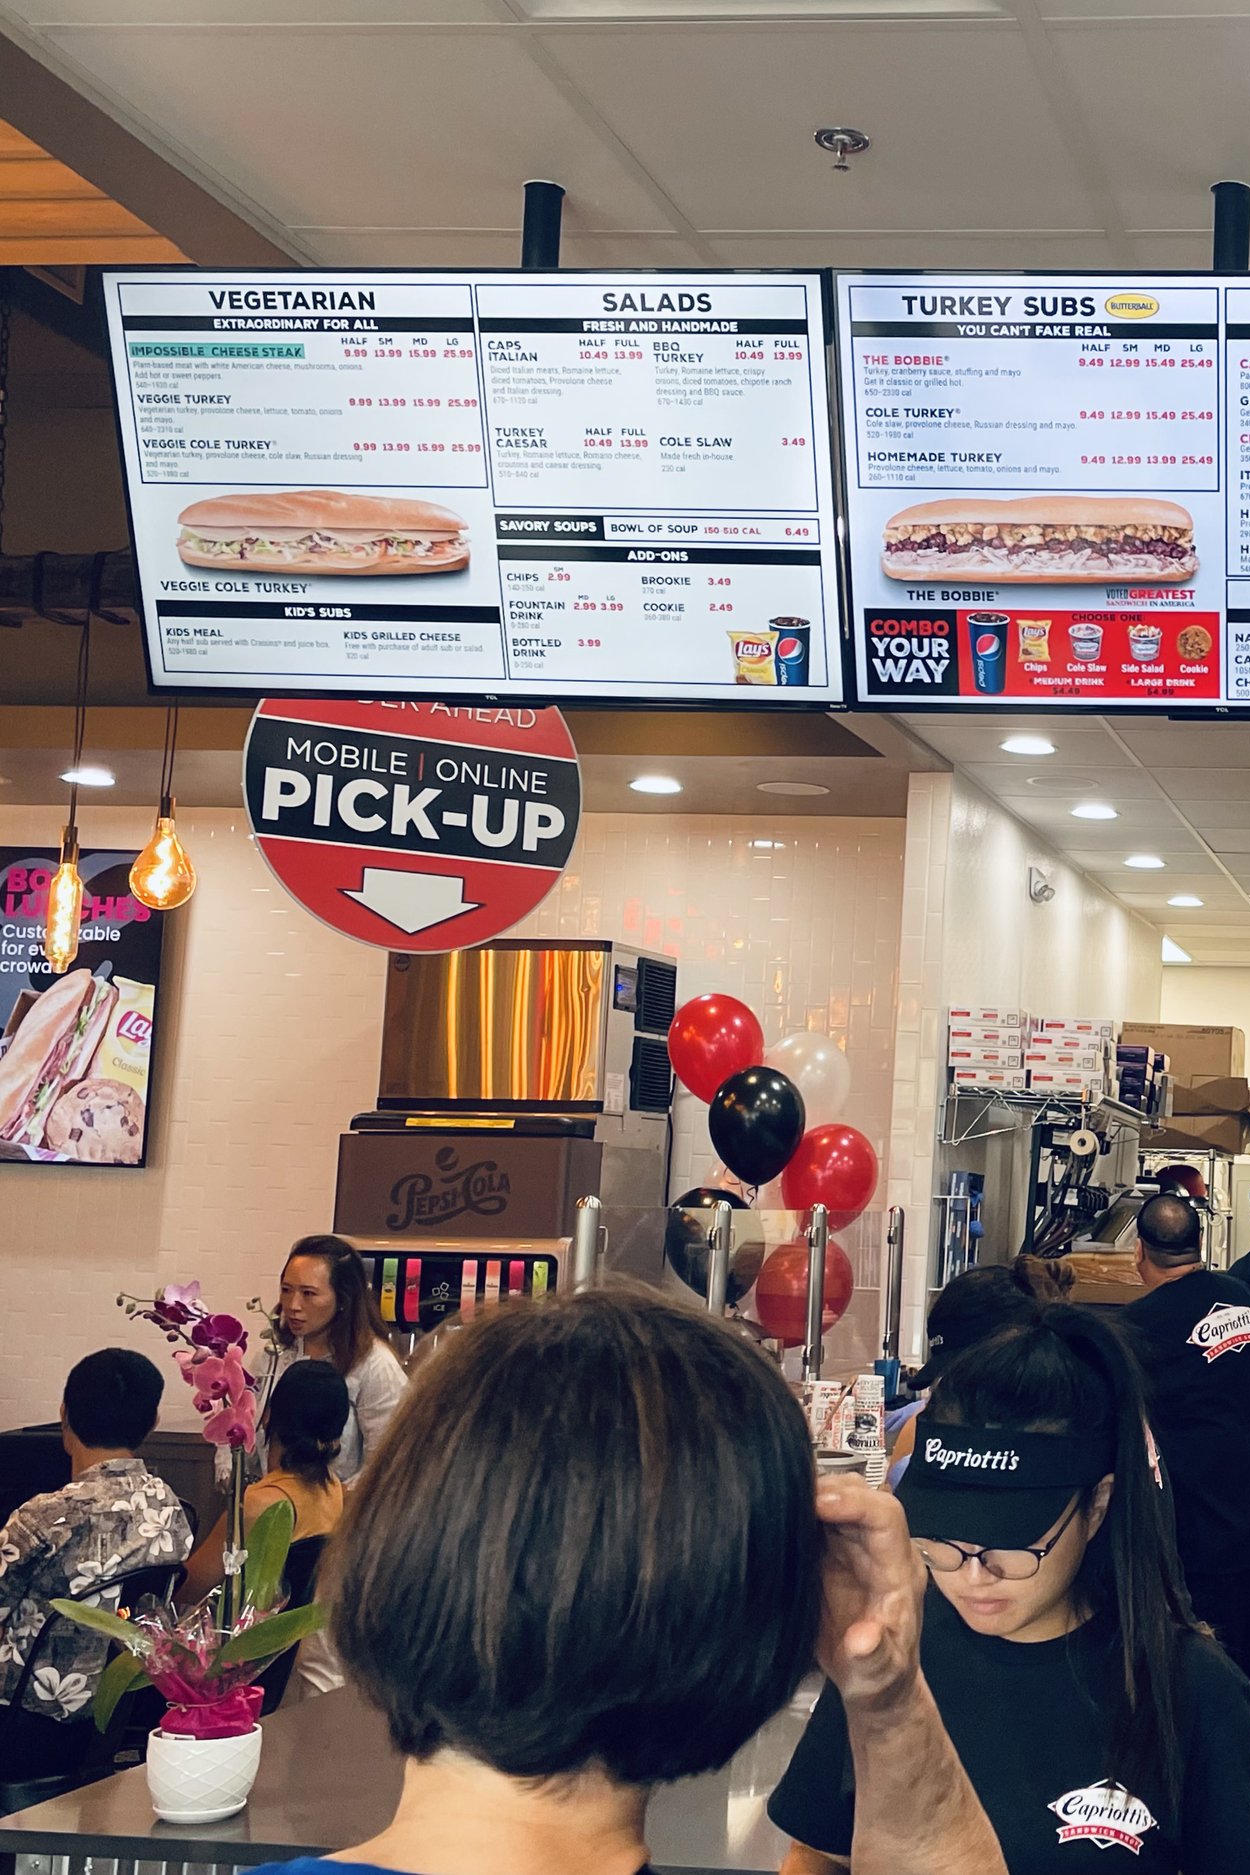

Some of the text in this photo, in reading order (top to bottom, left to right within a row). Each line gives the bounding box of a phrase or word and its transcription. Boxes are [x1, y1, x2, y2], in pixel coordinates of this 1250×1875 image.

[209, 290, 375, 310] VEGETARIAN
[602, 293, 712, 312] SALADS
[902, 296, 1012, 316] TURKEY
[1024, 296, 1096, 317] SUBS
[214, 318, 378, 330] EXTRAORDINARY FOR ALL
[583, 321, 738, 332] FRESH AND HANDMADE
[958, 325, 1111, 336] YOU CAN'T FAKE REAL
[488, 341, 521, 350] CAPS
[654, 342, 680, 351] BBQ
[131, 347, 302, 357] IMPOSSIBLE CHEESE STEAK
[488, 351, 643, 361] ITALIAN 10.49 13.99
[654, 353, 704, 363] TURKEY
[138, 394, 231, 404] VEGGIE TURKEY
[660, 437, 732, 447] COLE SLAW
[782, 438, 805, 446] 3.49
[868, 452, 1002, 462] HOMEMADE TURKEY
[500, 520, 596, 533] SAVORY SOUPS
[611, 524, 698, 533] BOWL OF SOUP
[785, 528, 809, 536] 6.49
[627, 550, 688, 562] ADD-ONS
[641, 577, 691, 586] BROOKIE
[1106, 589, 1195, 599] VOTED GREATEST
[285, 607, 351, 618] KID'S SUBS
[870, 619, 949, 634] COMBO
[344, 631, 461, 642] KIDS GRILLED CHEESE
[871, 638, 949, 657] YOUR
[872, 659, 949, 683] WAY
[1024, 663, 1047, 673] Chips
[1067, 663, 1106, 672] Cole Slaw
[1121, 663, 1164, 673] Side Salad
[1180, 664, 1208, 673] Cookie
[287, 737, 548, 794] MOBILE ONLINE
[262, 767, 565, 851] PICK-UP
[4, 894, 151, 922] LUCHES
[2, 924, 121, 941] Custozable
[1, 940, 25, 955] for
[112, 1057, 146, 1077] Classic
[925, 1438, 1019, 1470] Capriotti's
[1062, 1795, 1148, 1826] Capriotti's
